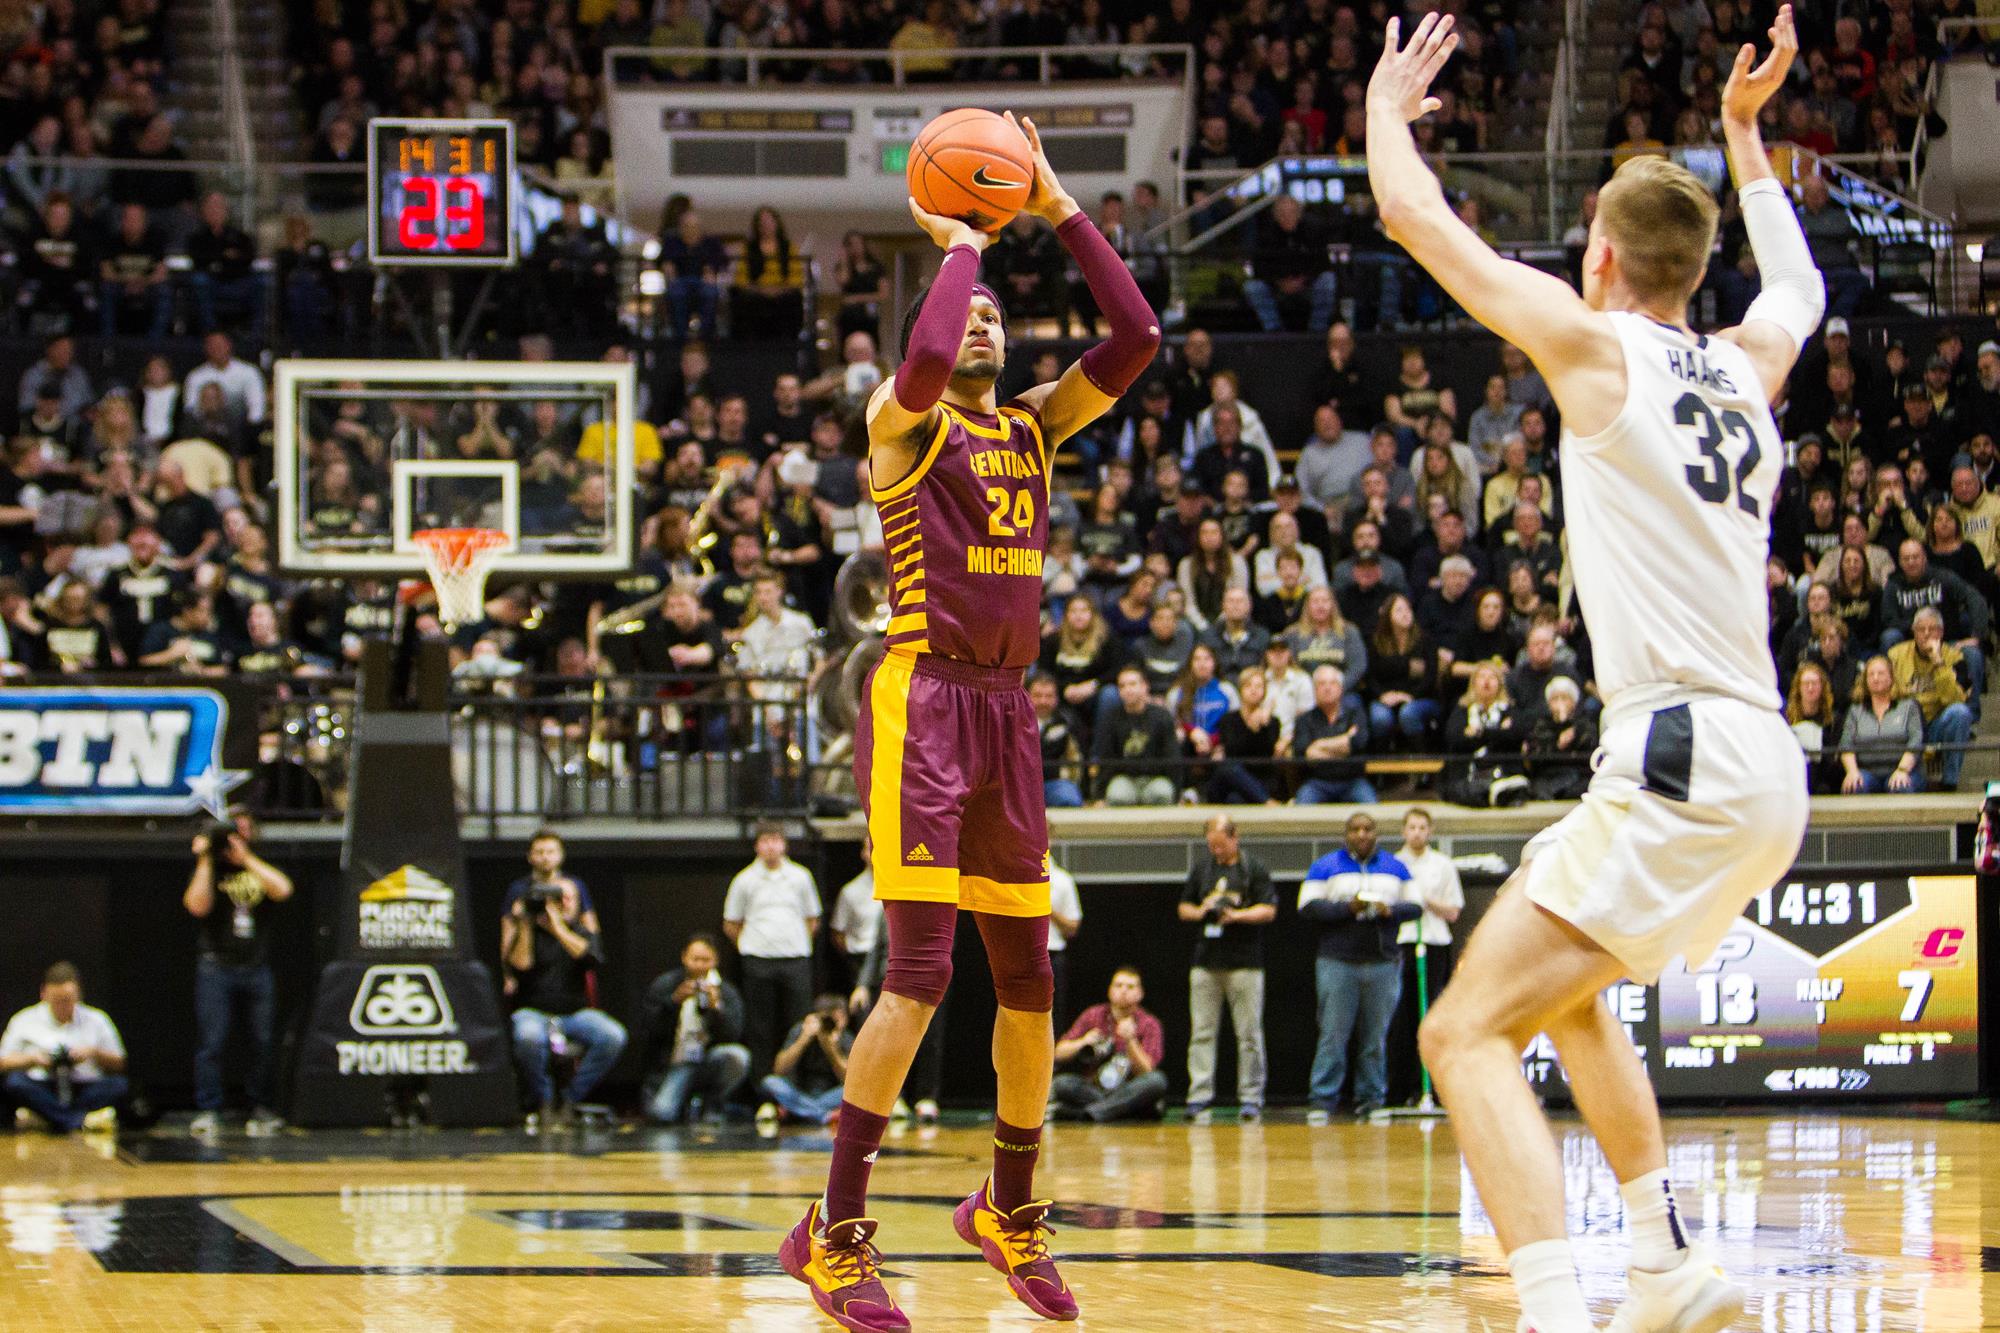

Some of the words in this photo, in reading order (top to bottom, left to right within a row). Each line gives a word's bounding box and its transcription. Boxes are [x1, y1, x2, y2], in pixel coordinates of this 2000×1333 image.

[399, 177, 484, 249] 23
[1674, 392, 1761, 518] 32
[987, 487, 1034, 537] 24
[967, 545, 1042, 576] MICHIGAN
[0, 709, 191, 787] BTN
[359, 902, 453, 920] PURDUE
[1754, 882, 1876, 926] 14:31
[359, 921, 451, 939] FEDERAL
[1696, 973, 1758, 1025] 13
[1796, 977, 1844, 1001] HALF
[1898, 970, 1933, 1022] 7
[1815, 1001, 1826, 1024] 1
[336, 1041, 468, 1075] PIONEER
